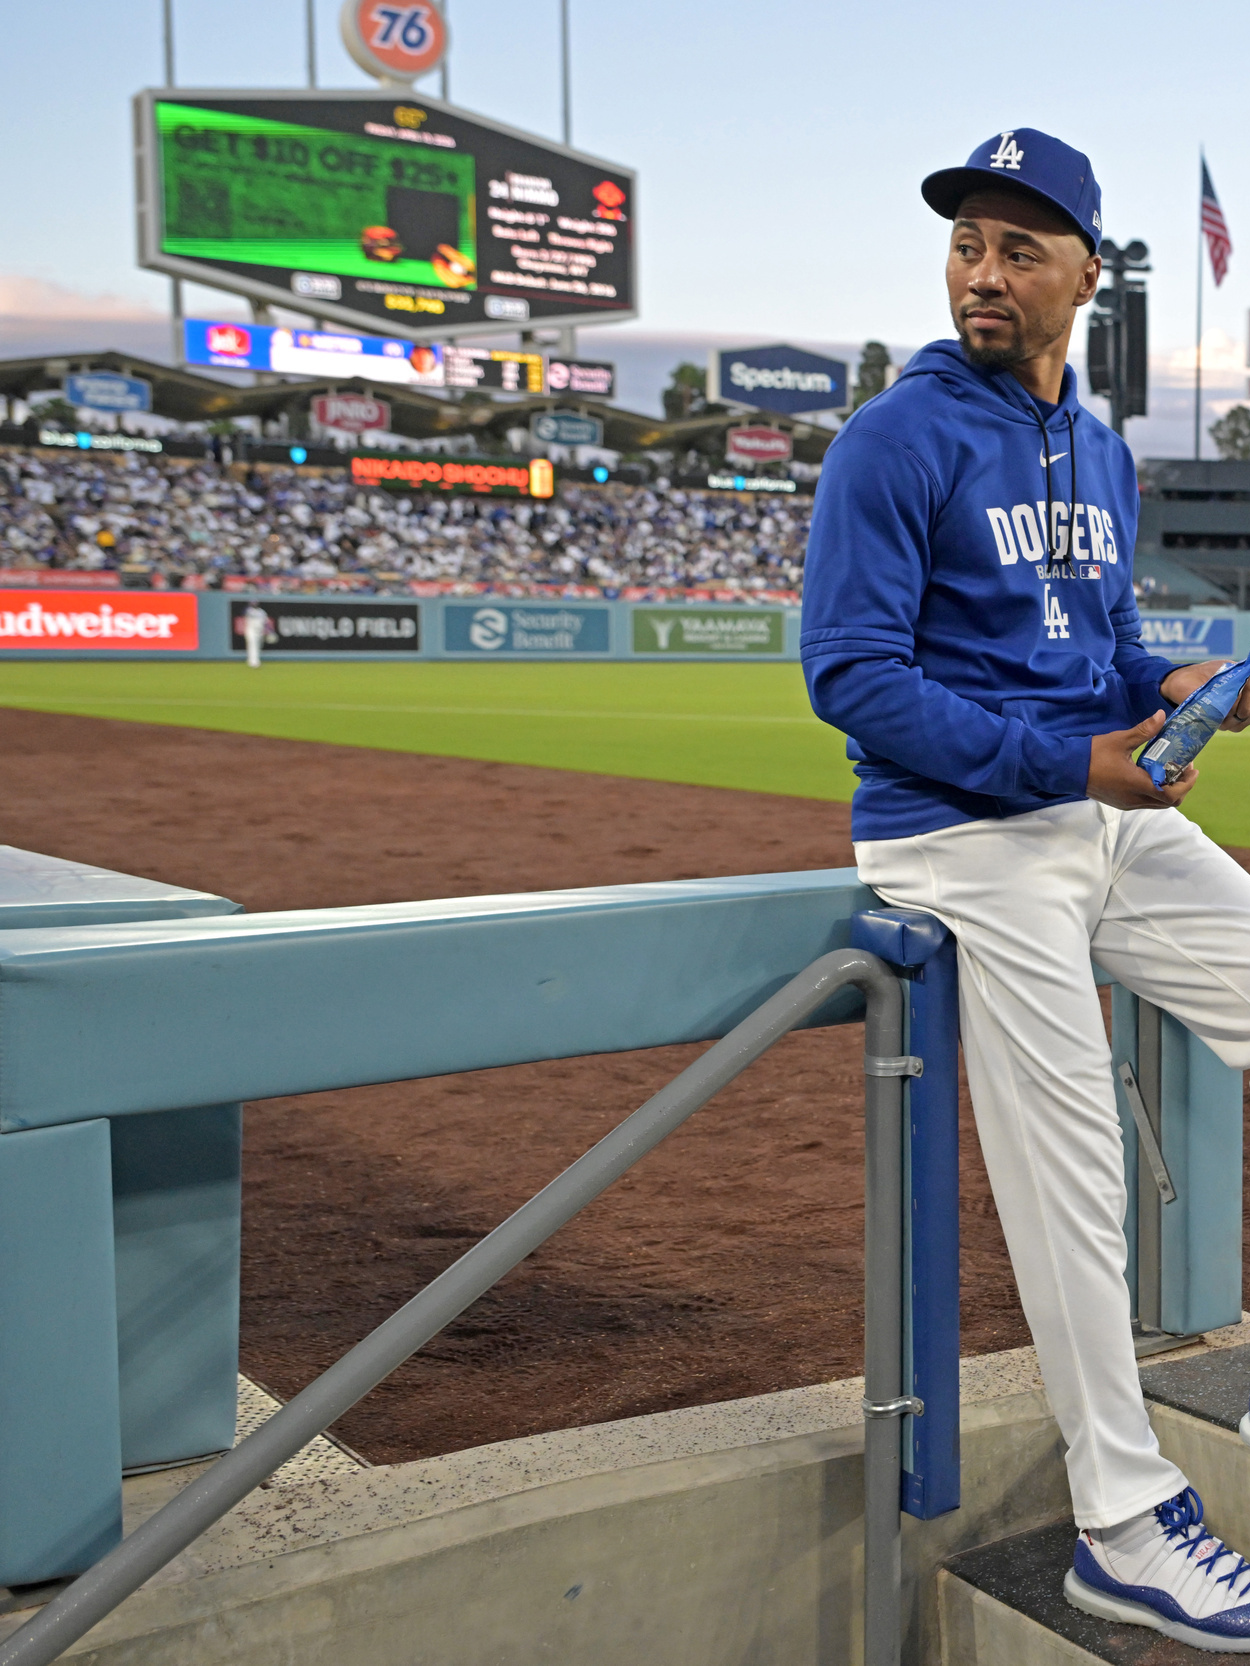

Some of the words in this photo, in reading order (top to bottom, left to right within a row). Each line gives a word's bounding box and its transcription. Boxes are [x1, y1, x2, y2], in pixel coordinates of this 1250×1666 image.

[369, 6, 432, 51] 76
[174, 125, 239, 156] GET
[318, 145, 379, 176] OFF
[990, 132, 1024, 170] LA
[730, 361, 831, 393] Spectrum
[352, 457, 442, 483] NIKAIDO
[0, 602, 178, 639] udweiser
[279, 616, 354, 640] UNIQLO
[357, 615, 416, 638] FIELD
[512, 610, 584, 635] Security
[1044, 583, 1070, 639] LA
[513, 631, 575, 651] Benefit
